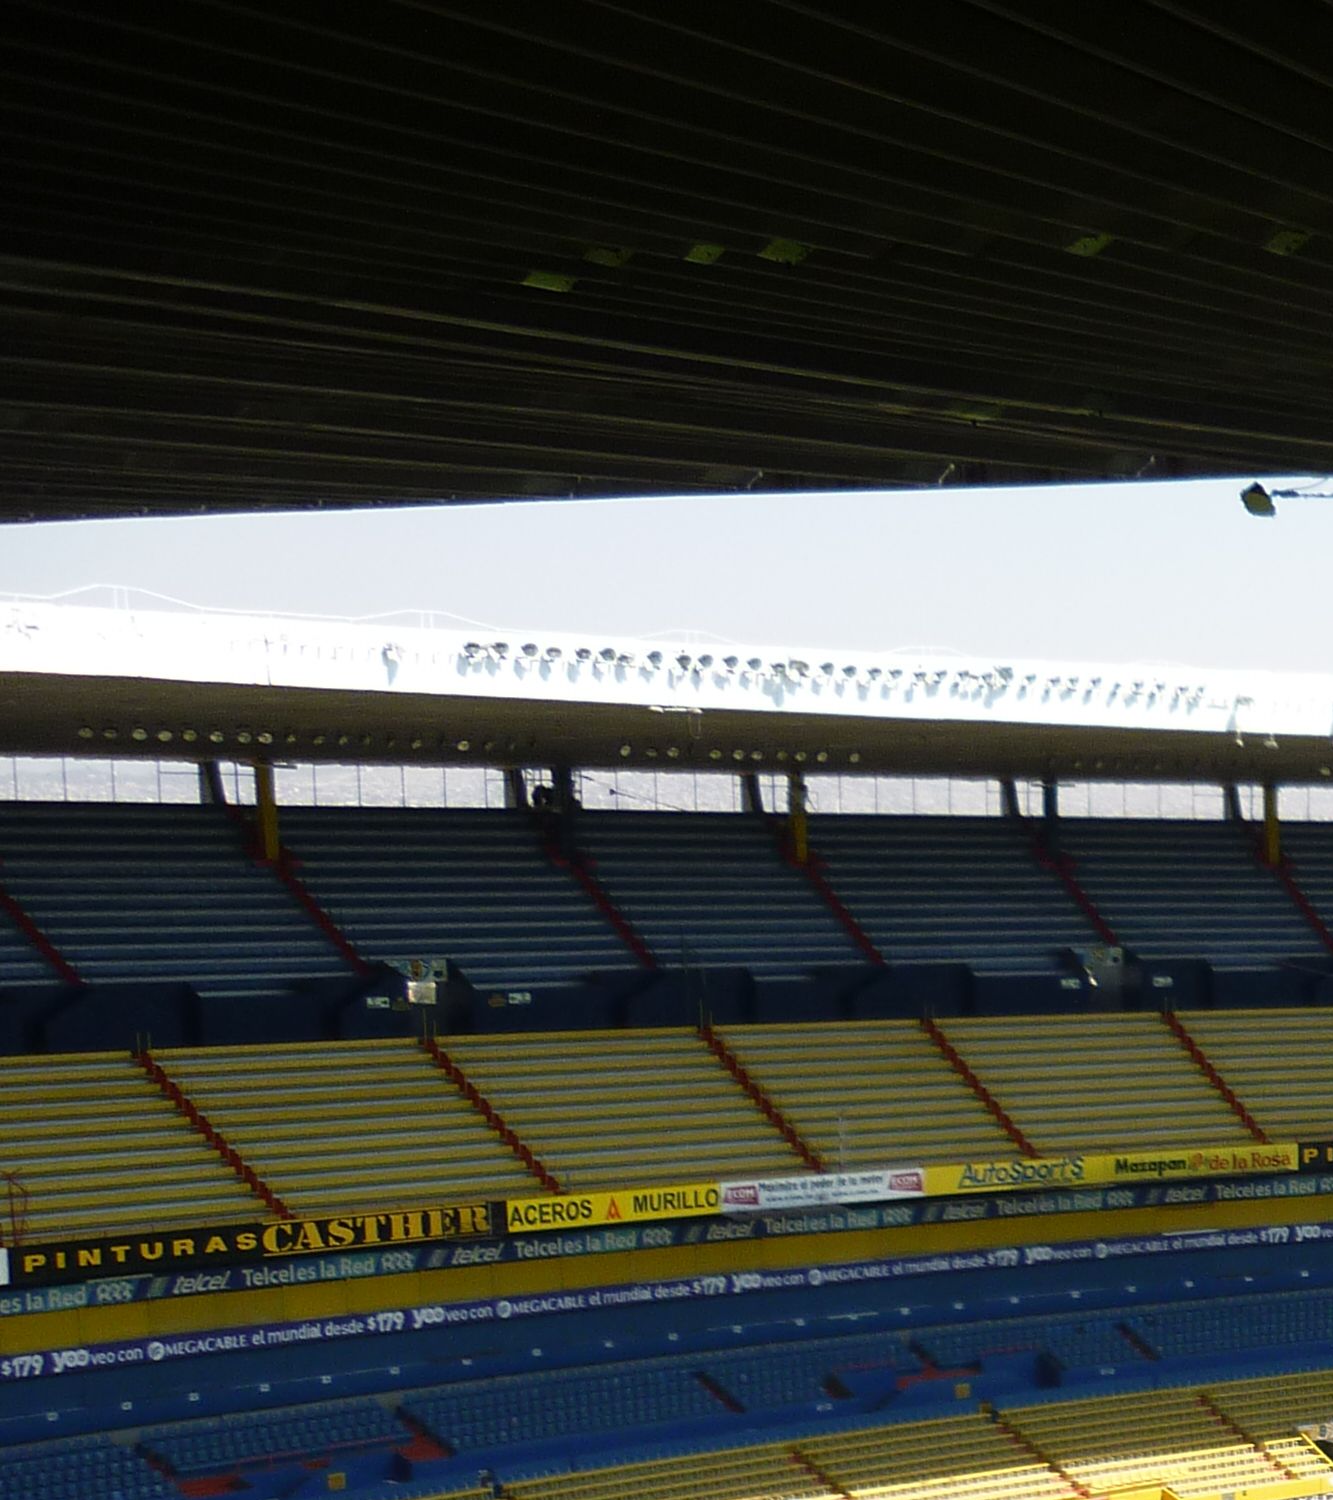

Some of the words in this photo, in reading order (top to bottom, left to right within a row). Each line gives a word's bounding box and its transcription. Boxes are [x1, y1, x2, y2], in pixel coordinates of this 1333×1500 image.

[1208, 1155, 1228, 1171] de
[1233, 1154, 1248, 1169] la
[1251, 1151, 1291, 1168] Rosa
[510, 1200, 593, 1228] ACEROS
[633, 1188, 719, 1214] MURILLO
[263, 1206, 490, 1254] CASTHER
[514, 1239, 560, 1259] Telcel
[586, 1234, 602, 1252] la
[605, 1229, 637, 1250] Red
[24, 1232, 258, 1274] PINTURAS
[242, 1267, 293, 1287] Telcel
[294, 1265, 317, 1282] es
[320, 1259, 337, 1278] la
[341, 1257, 374, 1276] Red
[25, 1293, 43, 1311] la
[47, 1289, 88, 1308] Red
[367, 1311, 404, 1334] $179
[512, 1293, 586, 1315] MEGACABLE
[588, 1292, 601, 1305] el
[603, 1286, 653, 1305] mundial
[654, 1284, 692, 1299] desde
[1, 1354, 45, 1379] $179
[117, 1348, 143, 1363] con
[164, 1334, 247, 1358] MEGACABLE
[252, 1332, 265, 1346] el
[266, 1322, 322, 1346] mundial
[325, 1319, 364, 1337] desde
